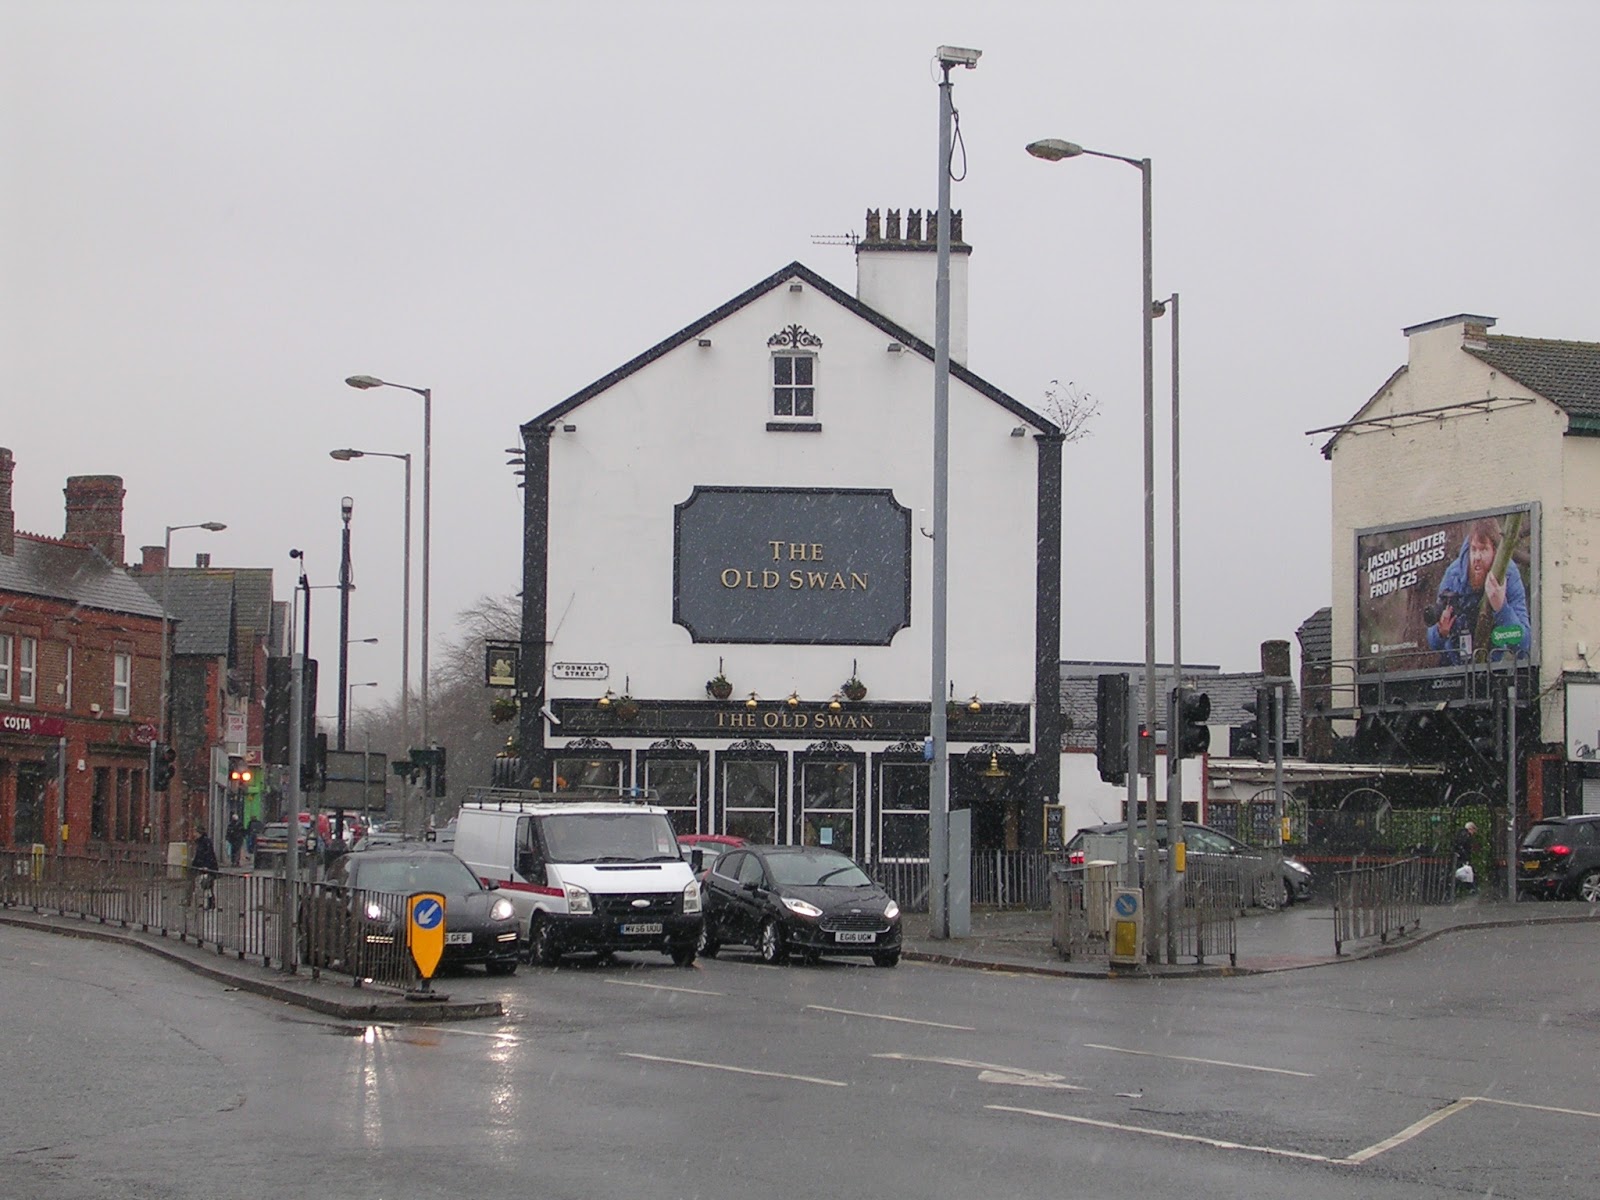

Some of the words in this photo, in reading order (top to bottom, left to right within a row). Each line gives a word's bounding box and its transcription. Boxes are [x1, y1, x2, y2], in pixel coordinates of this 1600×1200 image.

[768, 540, 824, 561] THE
[1367, 547, 1398, 573] JASON
[1399, 531, 1446, 558] SHUTTER
[1369, 561, 1401, 584] NEEDS
[1402, 545, 1446, 572] GLASSES
[720, 568, 780, 589] OLD
[789, 569, 869, 590] SWAN
[1370, 578, 1398, 599] FROM
[1399, 570, 1418, 589] £25
[3, 716, 31, 731] COSTA
[716, 712, 757, 728] THE
[763, 712, 808, 728] OLD
[814, 713, 874, 729] SWAN
